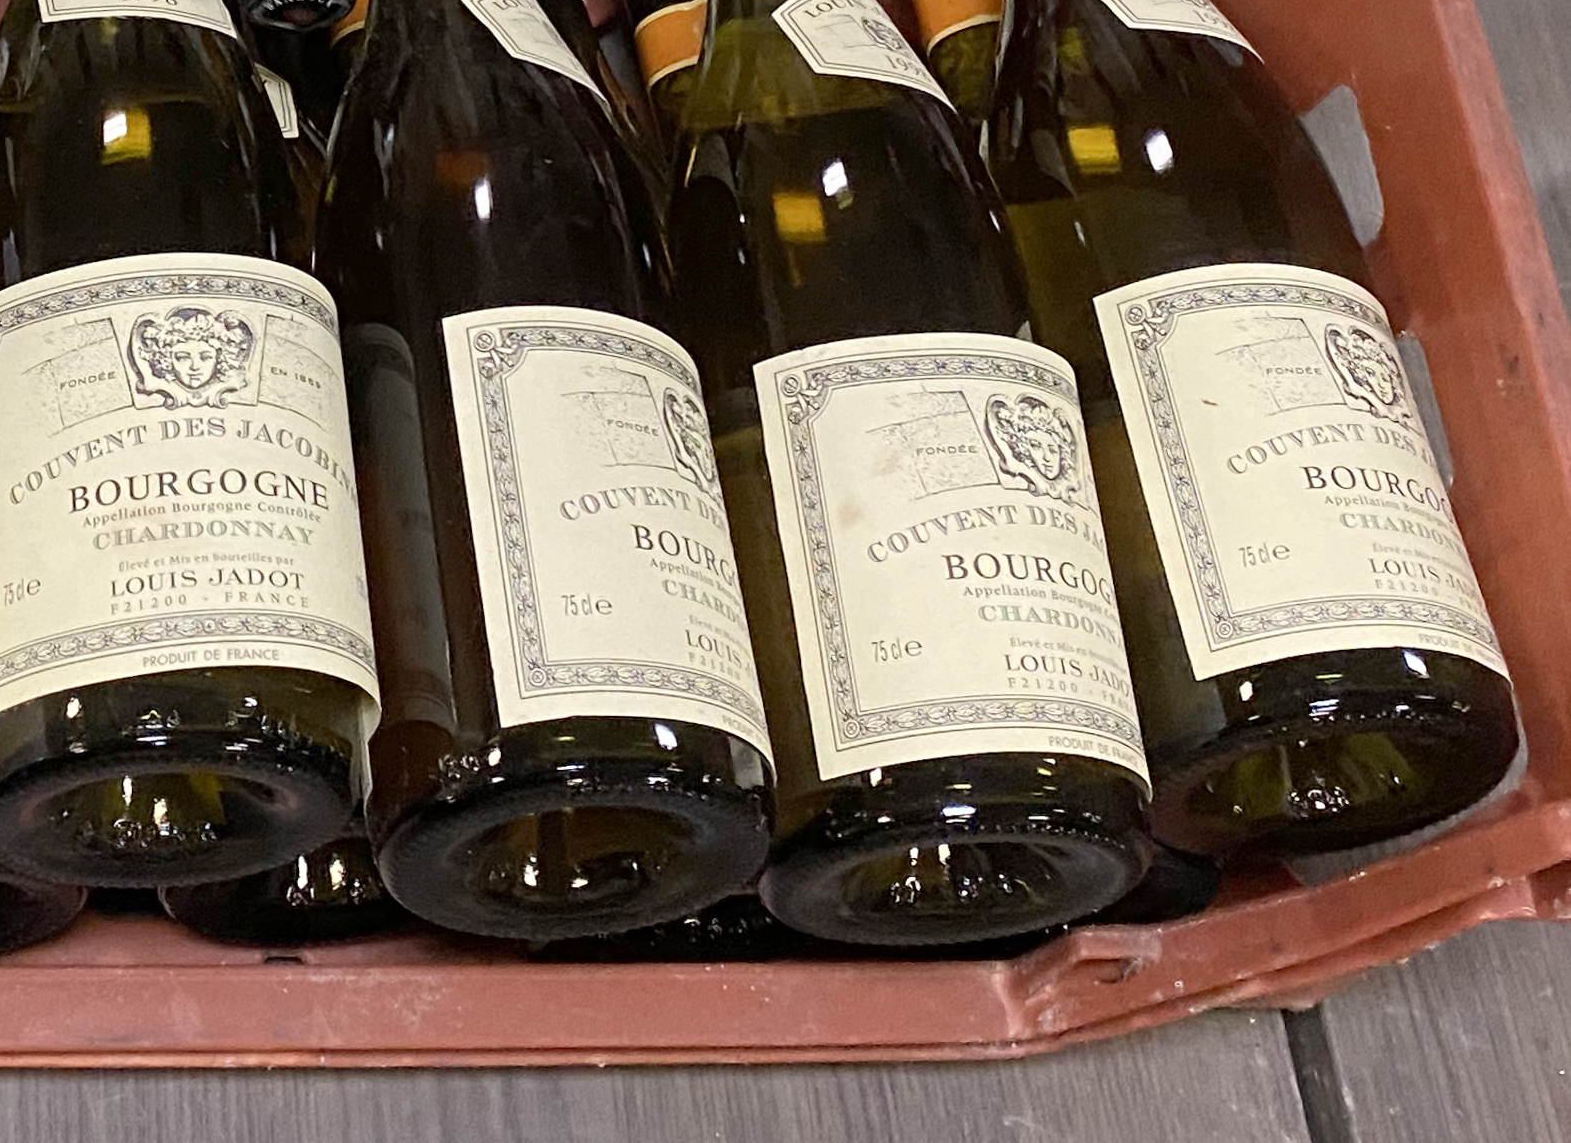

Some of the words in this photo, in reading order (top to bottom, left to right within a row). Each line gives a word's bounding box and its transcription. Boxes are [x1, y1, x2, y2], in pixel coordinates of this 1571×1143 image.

[59, 370, 116, 391] FONDÉE
[270, 366, 288, 377] EN
[1265, 365, 1324, 377] FONDÉE
[606, 418, 660, 438] FONDÉE
[915, 444, 978, 457] FONDÉE
[1226, 424, 1365, 475] COUVENT
[1373, 425, 1415, 456] DES
[8, 424, 148, 506] COUVENT
[159, 418, 226, 440] DES
[68, 469, 330, 515] BOURGOGNE
[559, 485, 691, 521] COUVENT
[1324, 494, 1400, 509] Appellation
[81, 503, 167, 529] Appellation
[171, 501, 252, 515] Bourgogne
[257, 499, 322, 524] Contrôlée
[92, 521, 315, 552] CHARDONNAY
[866, 504, 1018, 565] COUVENT
[1025, 503, 1077, 535] DES
[168, 554, 192, 566] Mis
[211, 553, 272, 566] bouteilles
[275, 555, 295, 568] par
[1369, 557, 1439, 584] LOUIS
[110, 571, 198, 599] LOUIS
[208, 569, 305, 592] JADOT
[649, 558, 716, 588] Appellation
[224, 591, 311, 609] FRANCE
[962, 585, 1047, 599] Appellation
[142, 650, 198, 669] PRODUIT
[203, 649, 221, 661] DE
[226, 648, 280, 661] FRANCE
[685, 628, 743, 669] LOUIS
[1004, 653, 1083, 677] LOUIS
[1048, 736, 1095, 752] PRODUIT
[1098, 742, 1109, 755] DE
